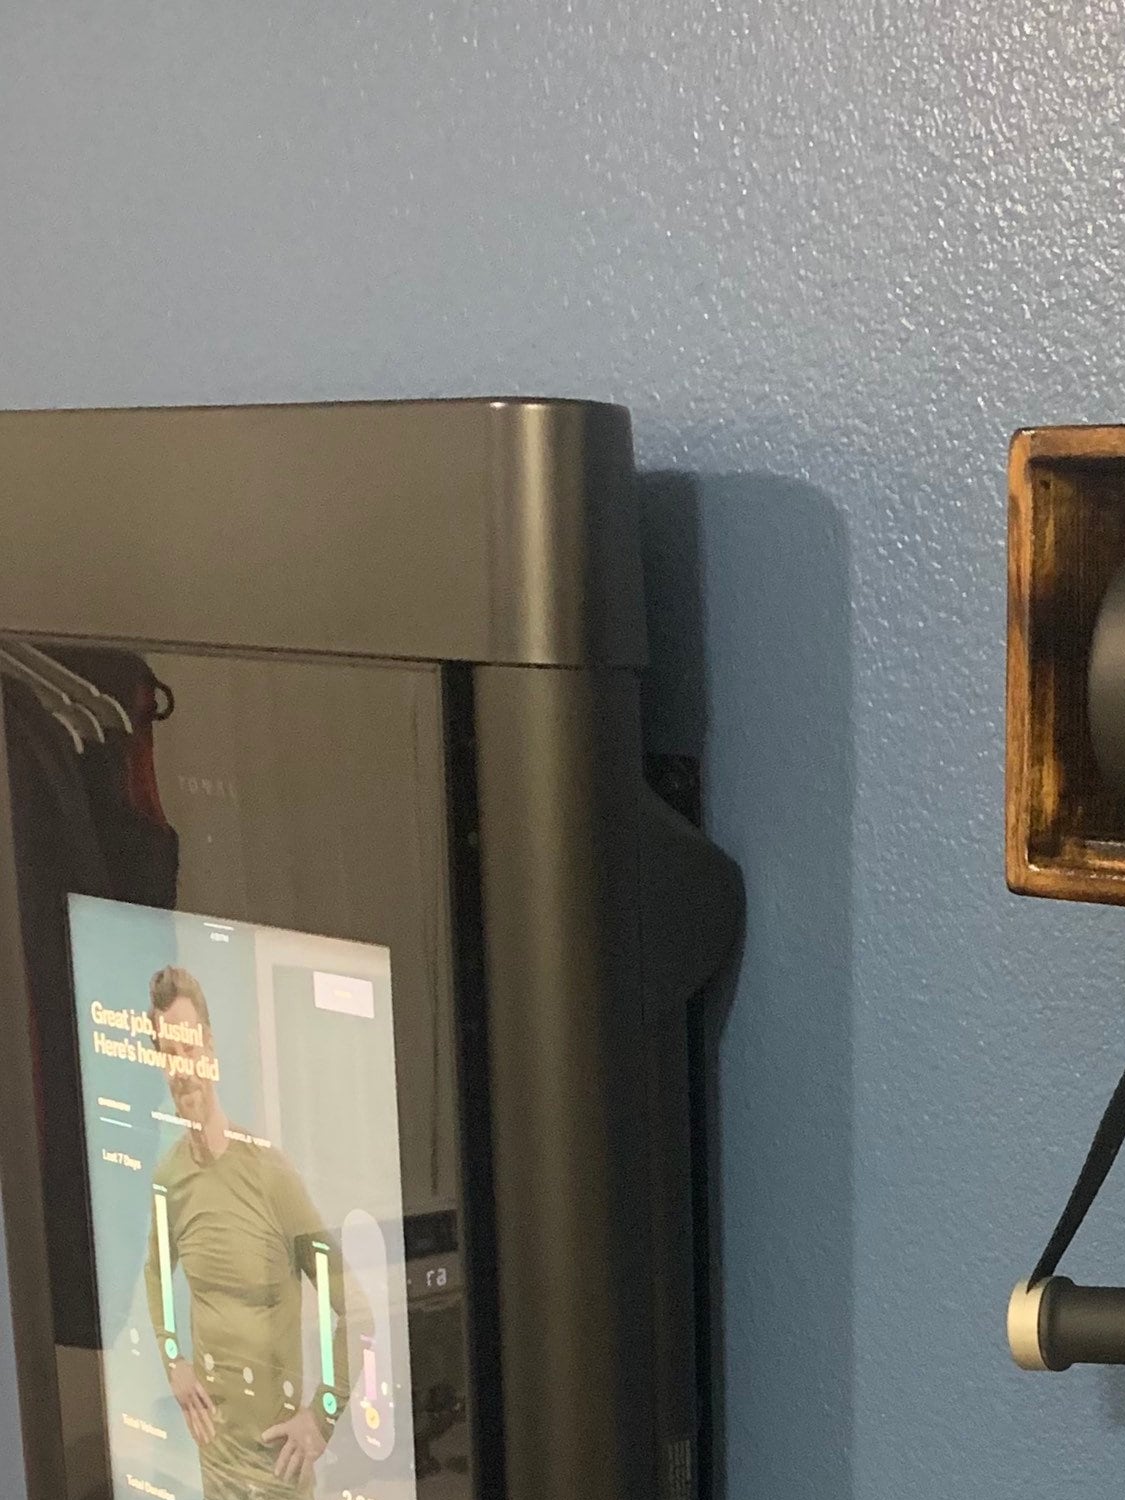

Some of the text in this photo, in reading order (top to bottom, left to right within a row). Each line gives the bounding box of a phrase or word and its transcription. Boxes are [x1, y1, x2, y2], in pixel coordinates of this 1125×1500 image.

[91, 1000, 130, 1031] Great
[130, 1009, 157, 1041] job,
[93, 1031, 220, 1082] Here's how you did
